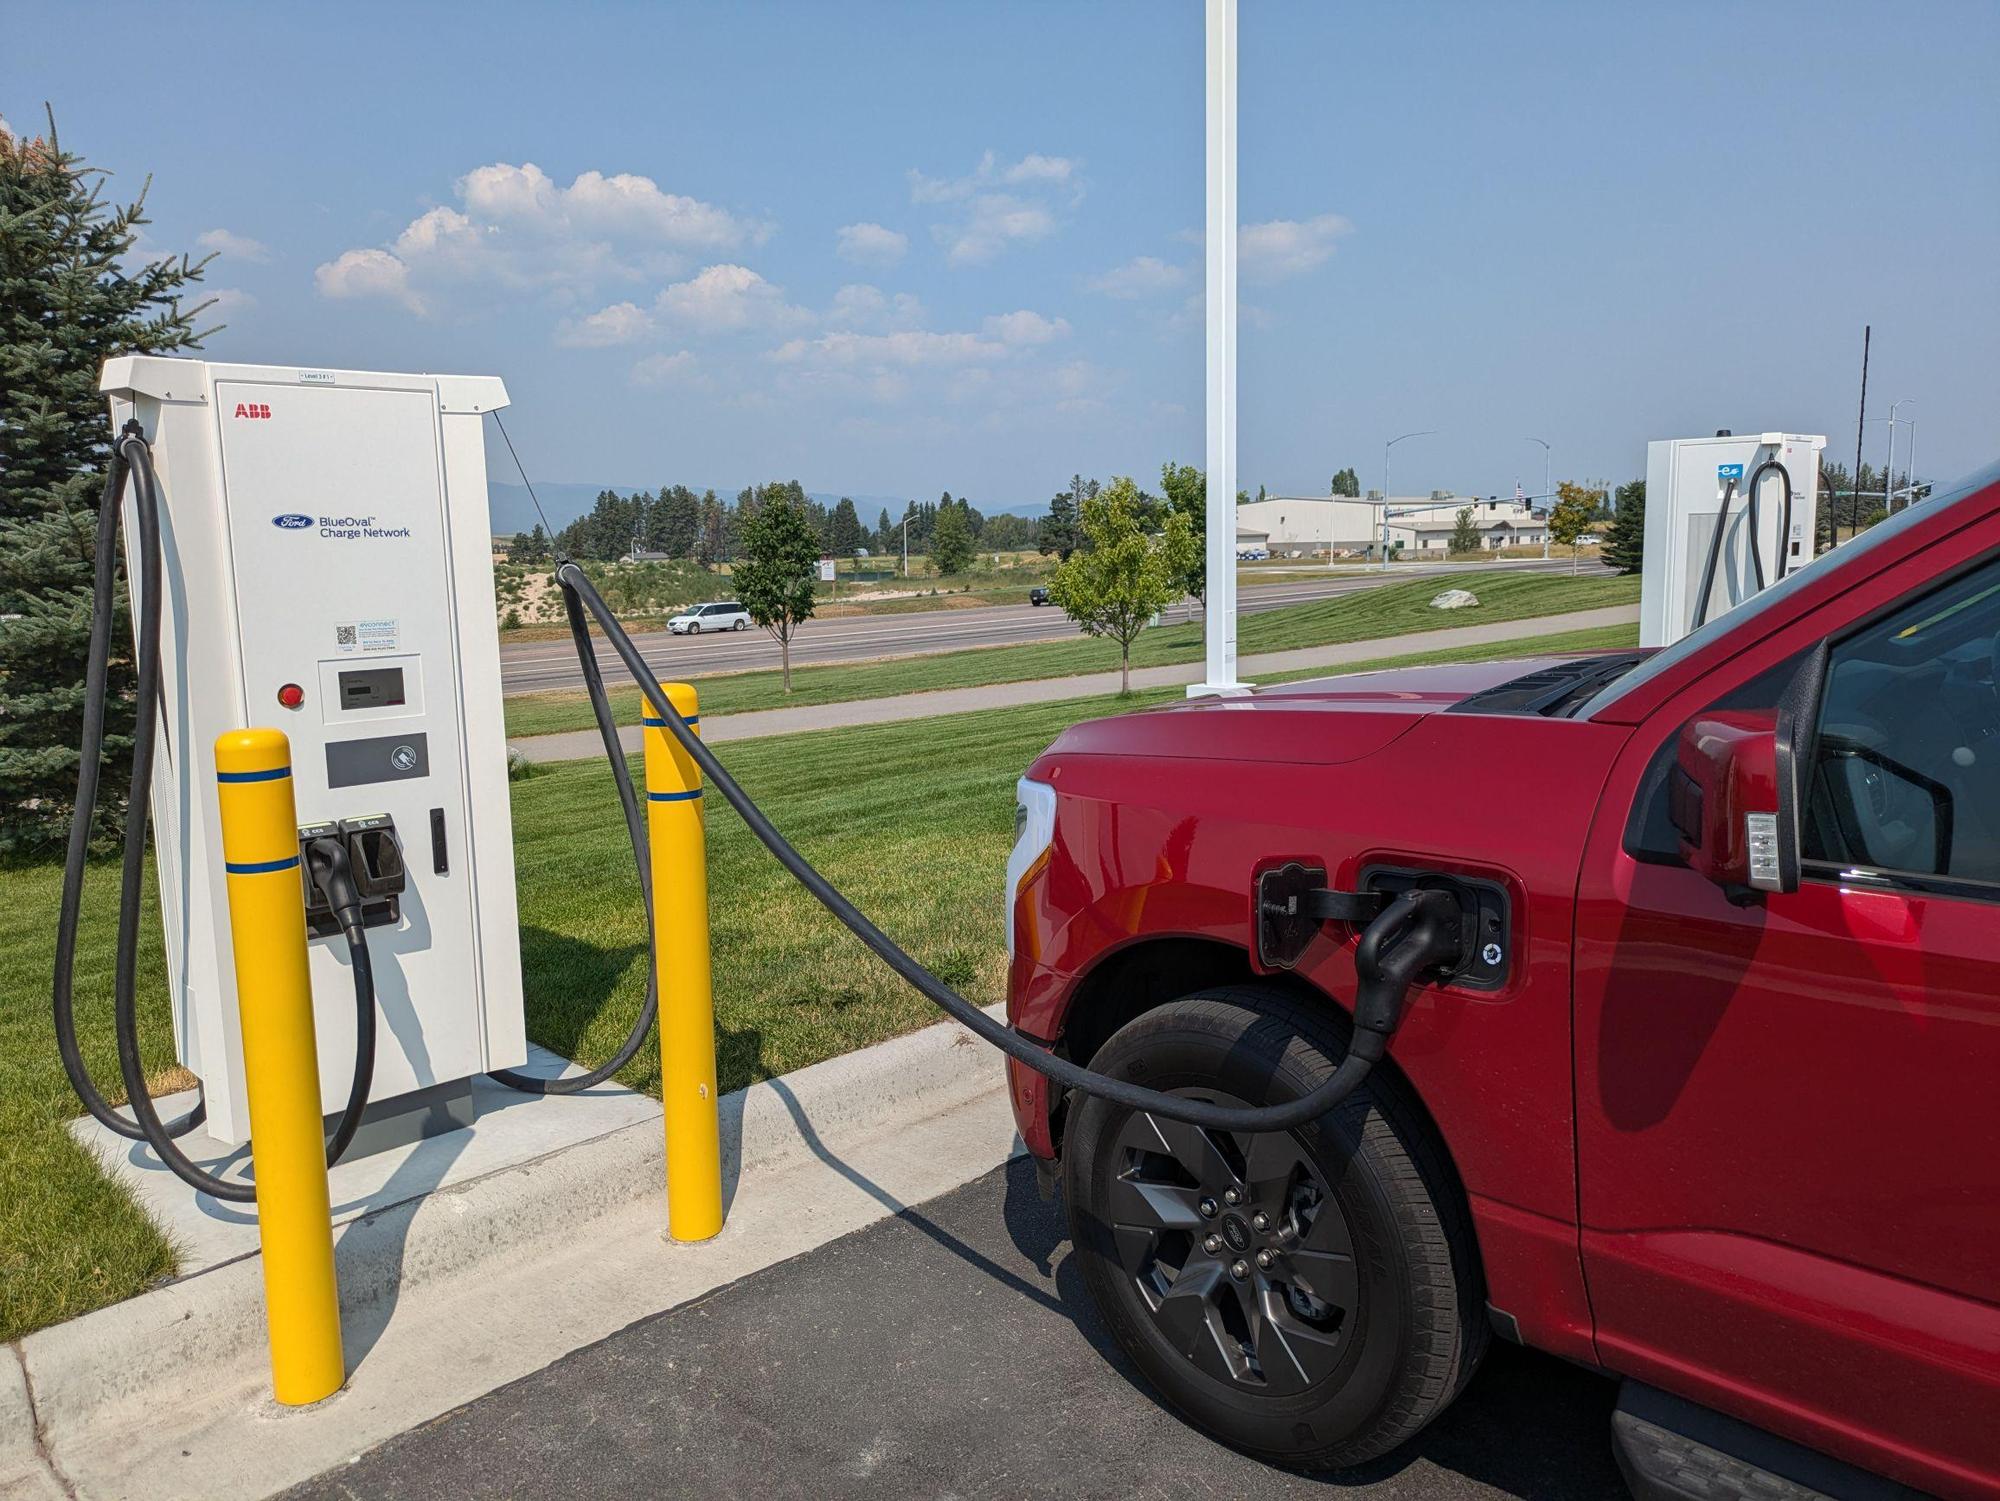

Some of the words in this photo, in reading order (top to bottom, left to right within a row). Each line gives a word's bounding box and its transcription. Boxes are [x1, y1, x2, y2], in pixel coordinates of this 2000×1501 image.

[235, 404, 271, 419] ABB
[279, 515, 308, 529] Ford
[320, 528, 361, 539] Charge
[363, 528, 411, 538] Network
